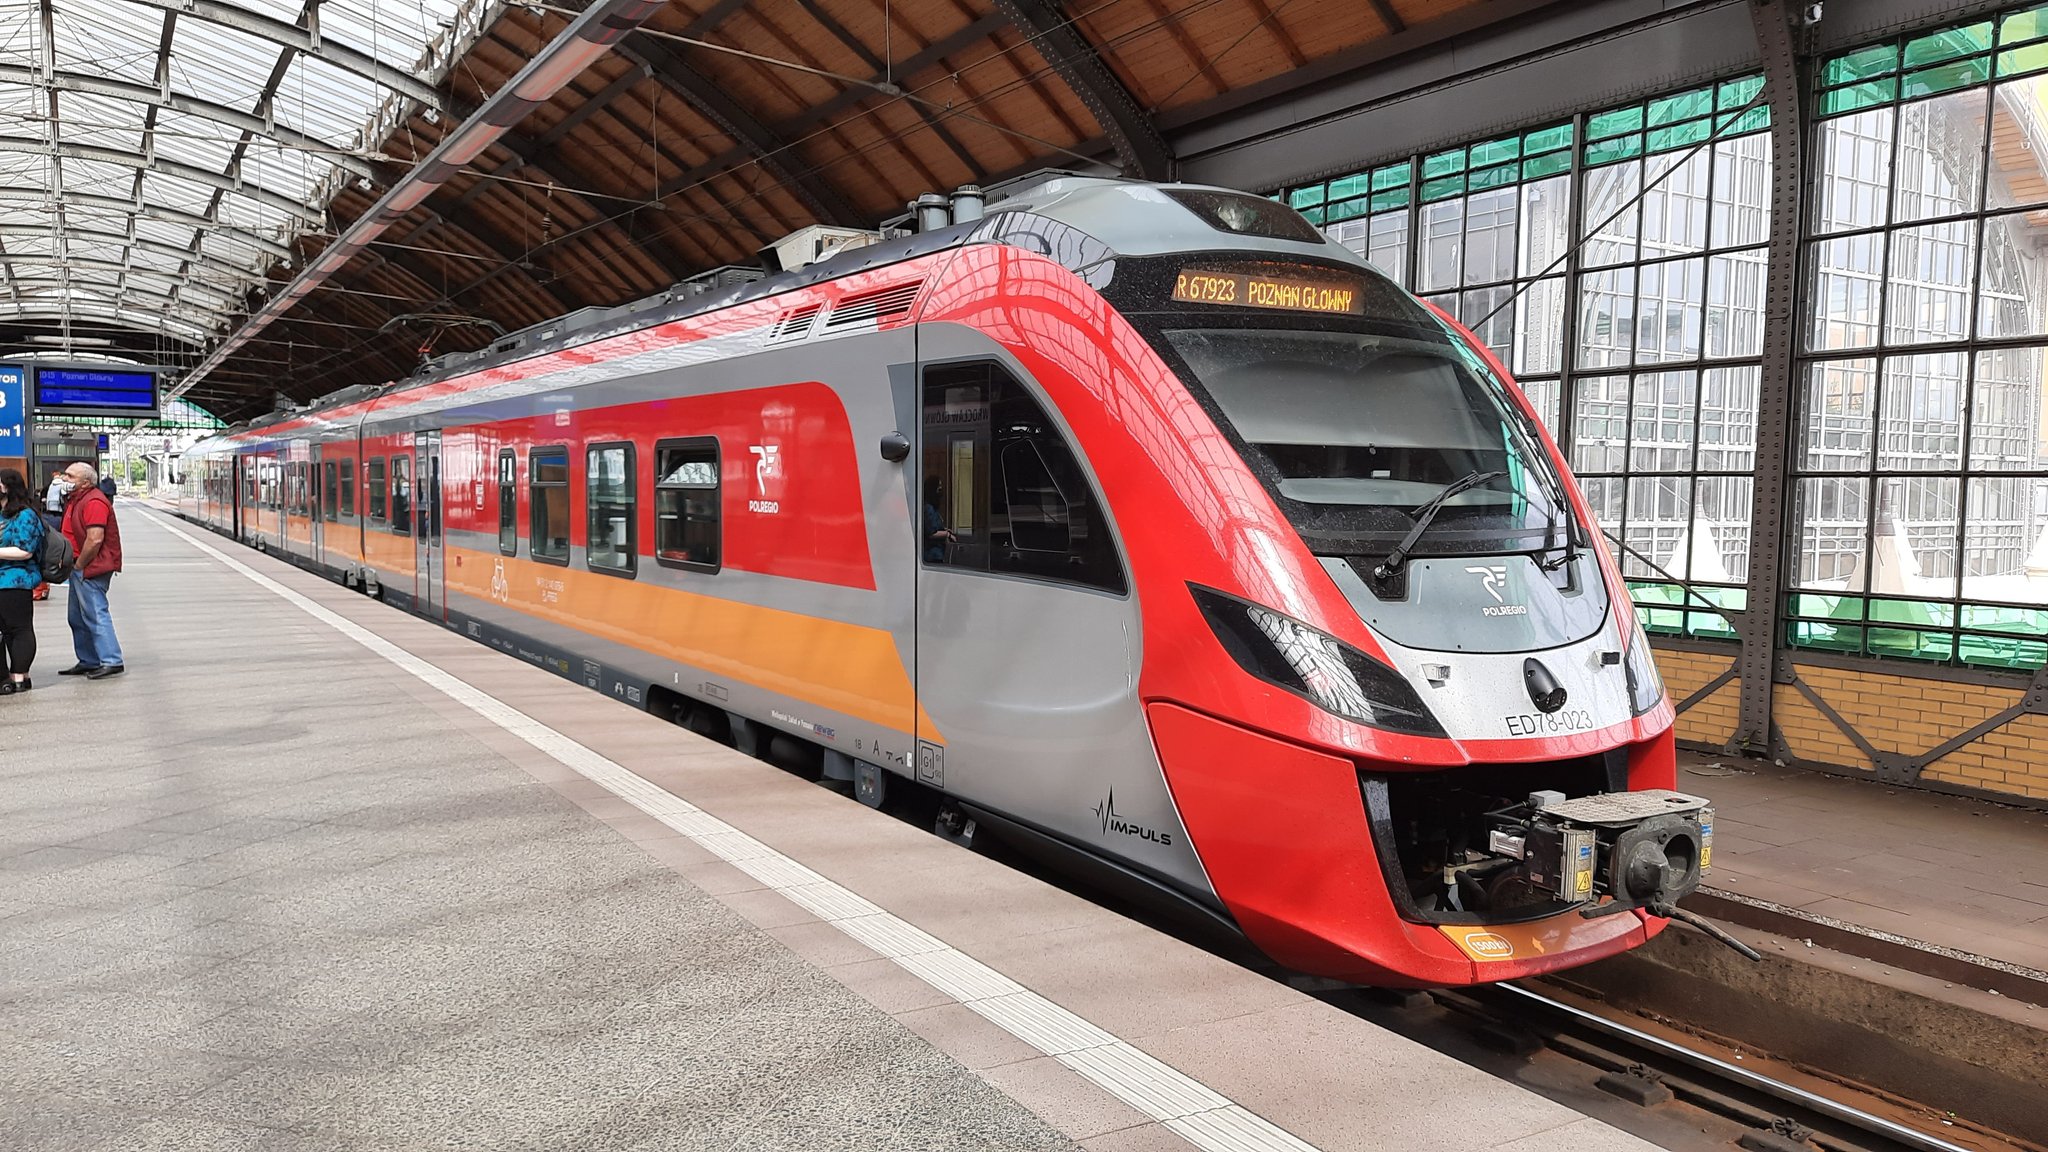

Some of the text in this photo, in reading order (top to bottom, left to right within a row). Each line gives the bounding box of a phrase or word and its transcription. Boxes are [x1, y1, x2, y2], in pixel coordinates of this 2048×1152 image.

[1177, 274, 1187, 298] R
[1190, 276, 1236, 302] 67923
[13, 424, 21, 437] 1
[748, 500, 779, 514] POLREGIO
[1482, 605, 1527, 617] POLREGIO
[1505, 710, 1594, 737] ED78-023
[1110, 819, 1172, 846] IMPULS
